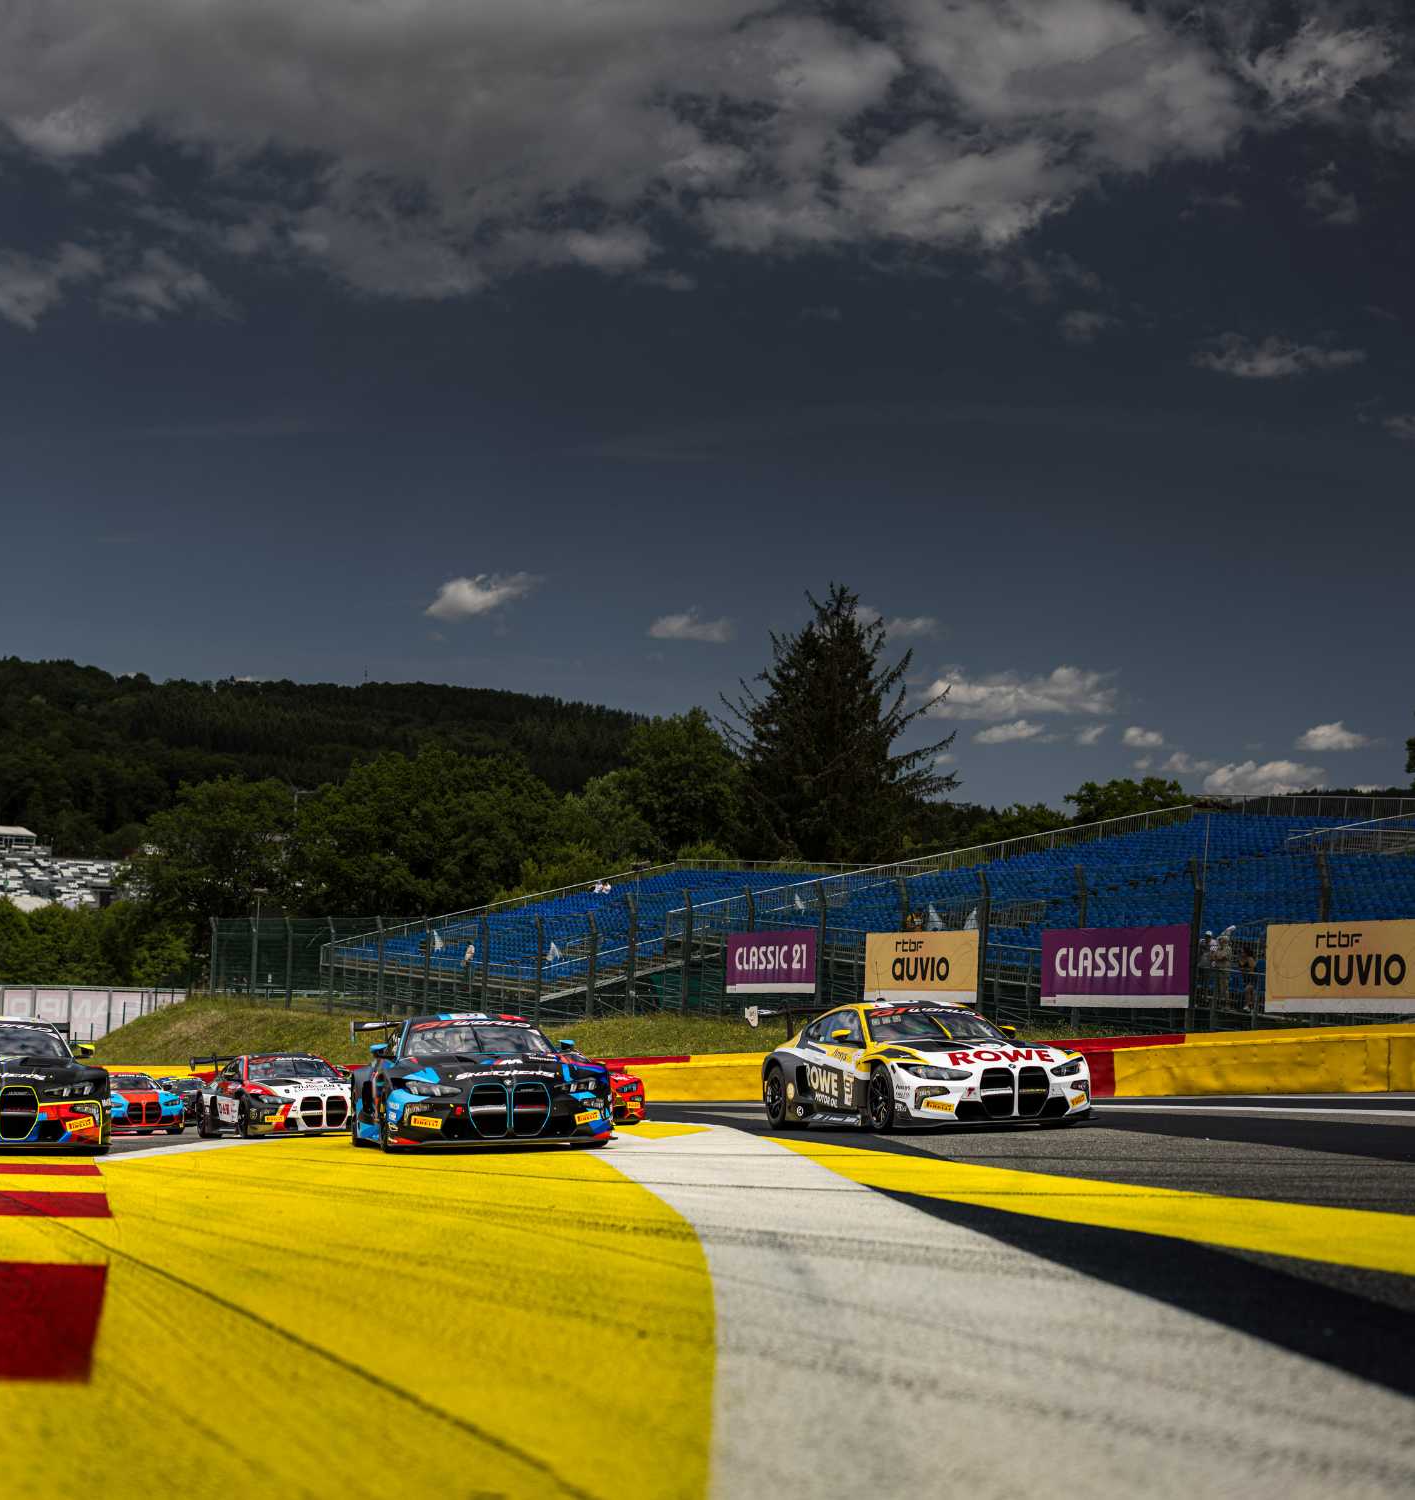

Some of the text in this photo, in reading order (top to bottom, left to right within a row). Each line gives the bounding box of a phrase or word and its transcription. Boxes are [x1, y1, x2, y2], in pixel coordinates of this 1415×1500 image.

[735, 944, 807, 970] CLASSIC 21
[1055, 944, 1174, 977] CLASSIC 21
[908, 1007, 976, 1016] WORLD
[453, 1020, 531, 1028] WORLD
[947, 1050, 1055, 1066] ROWE
[455, 1070, 555, 1080] SKECHERS
[815, 1092, 831, 1106] MOTOR
[413, 1117, 439, 1127] PIRELLI
